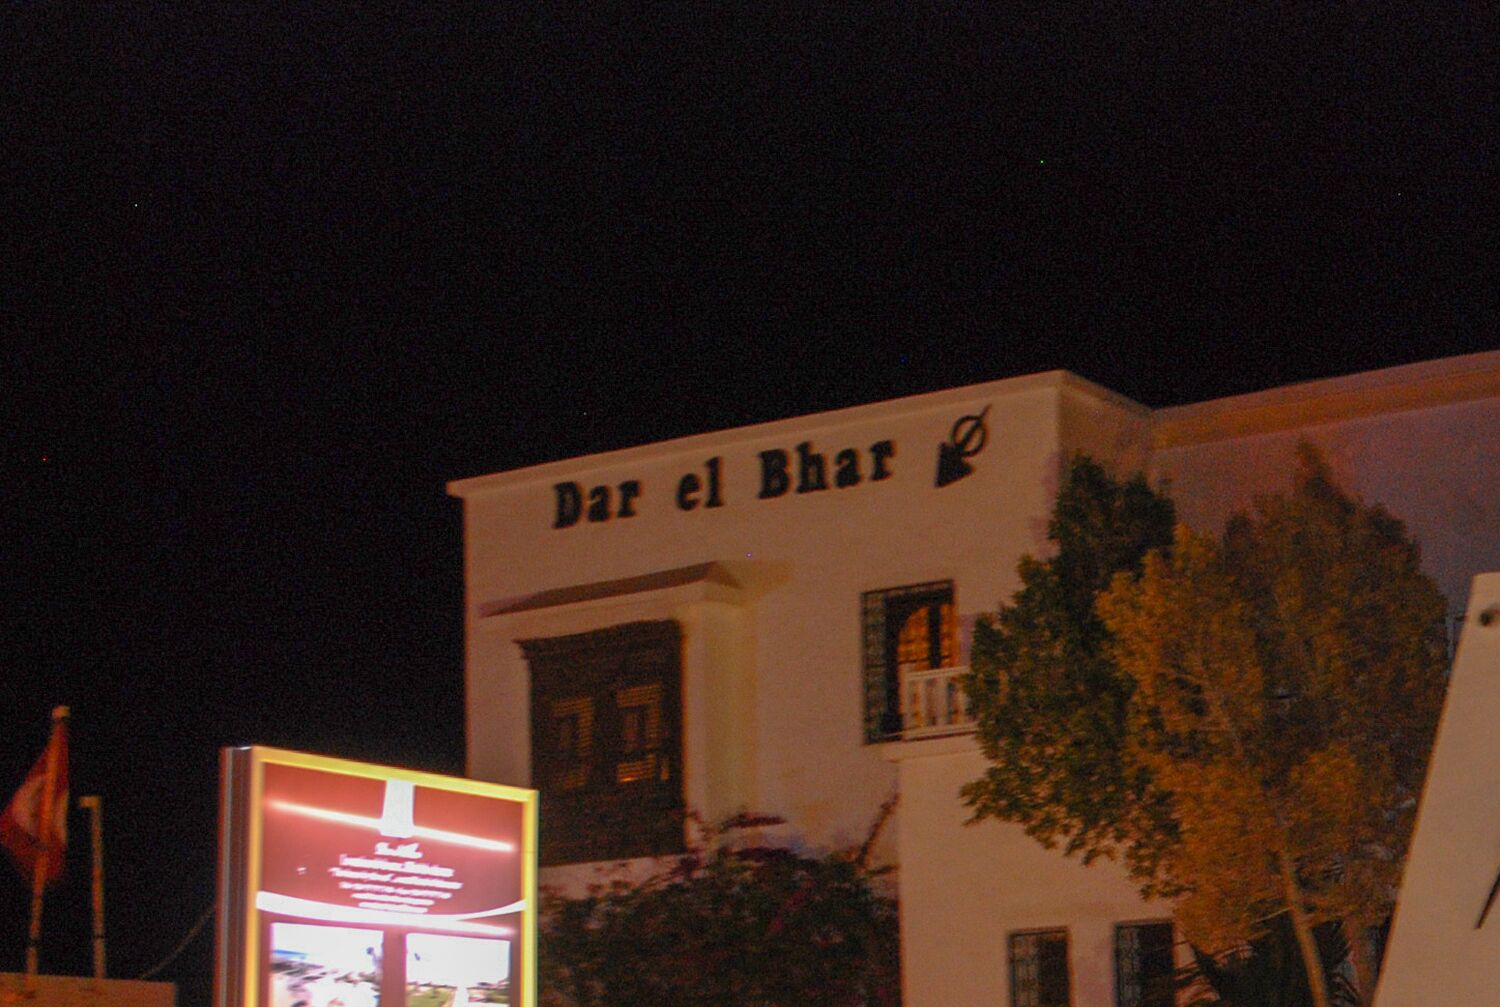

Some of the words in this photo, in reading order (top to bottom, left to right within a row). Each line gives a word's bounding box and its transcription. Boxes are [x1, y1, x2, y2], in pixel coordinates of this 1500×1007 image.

[553, 479, 642, 529] Dar
[675, 456, 725, 512] el
[758, 436, 897, 500] Bhar
